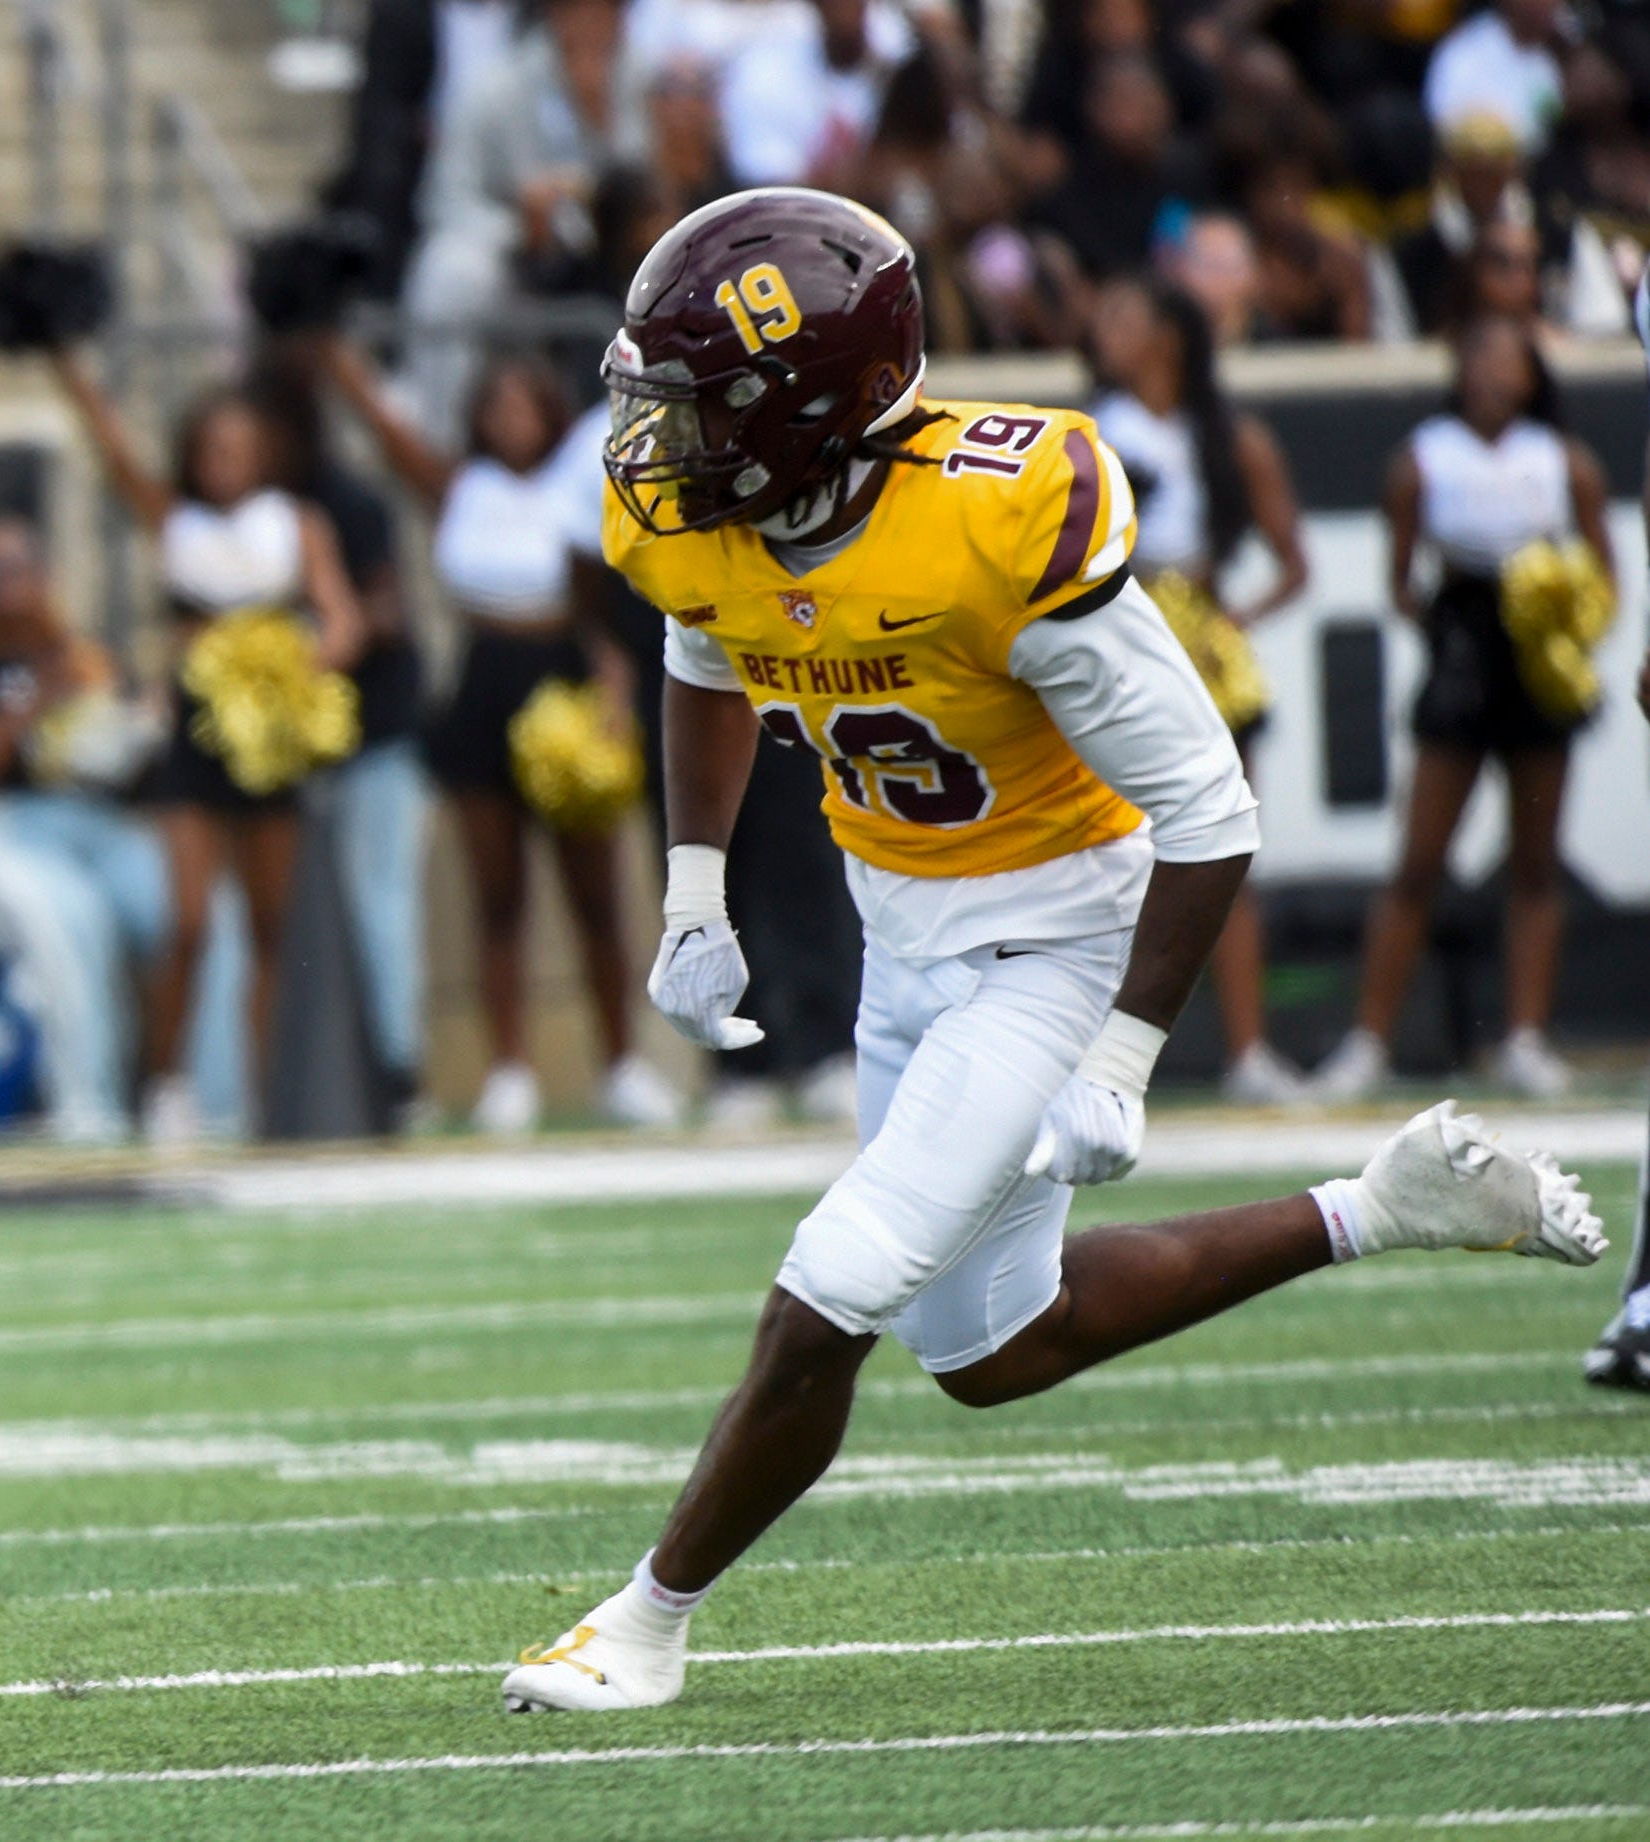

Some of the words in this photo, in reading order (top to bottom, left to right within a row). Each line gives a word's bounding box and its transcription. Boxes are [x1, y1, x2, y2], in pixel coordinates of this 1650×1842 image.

[714, 262, 802, 355] 19
[942, 411, 1052, 479] 19
[739, 652, 916, 695] BETHUNE
[754, 699, 998, 830] 19
